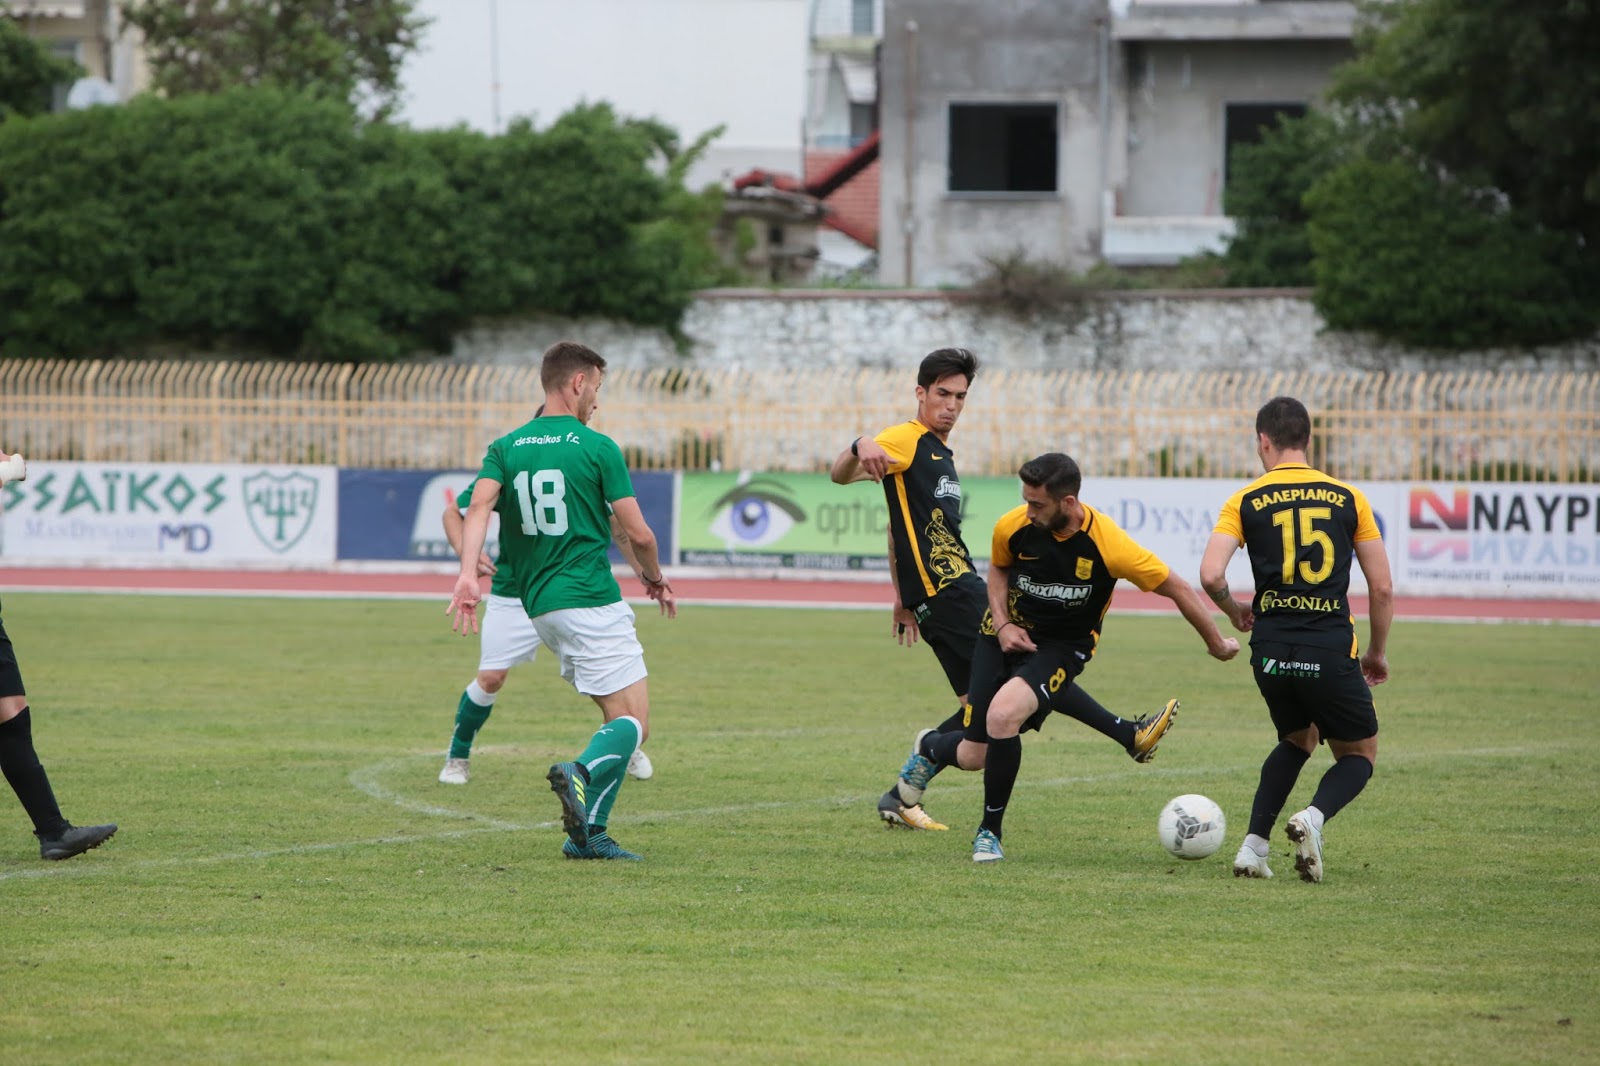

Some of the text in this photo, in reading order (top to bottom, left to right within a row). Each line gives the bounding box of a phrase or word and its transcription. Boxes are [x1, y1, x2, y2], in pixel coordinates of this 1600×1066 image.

[513, 435, 561, 447] dessaikos
[514, 469, 568, 536] 18
[1272, 508, 1335, 585] 15
[1018, 577, 1089, 600] STOIXIMAN
[1049, 667, 1065, 693] 8
